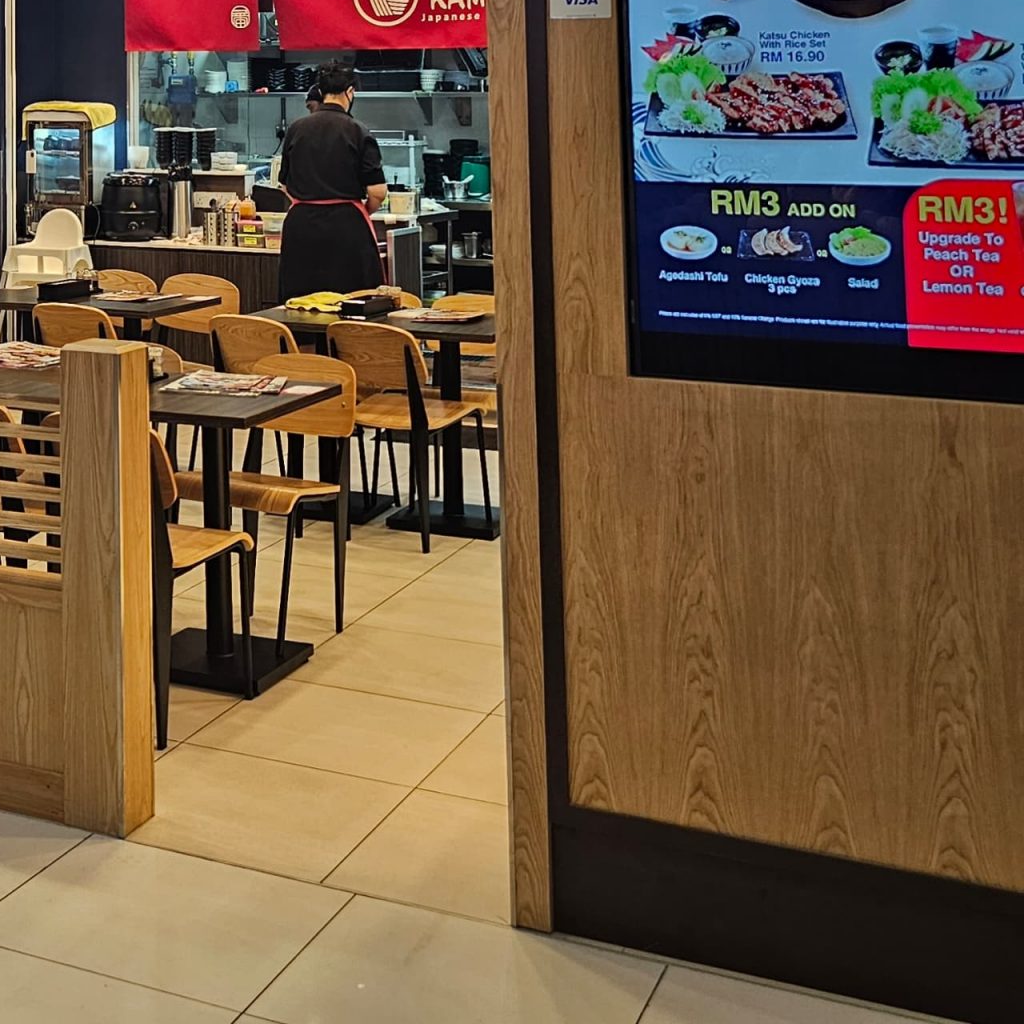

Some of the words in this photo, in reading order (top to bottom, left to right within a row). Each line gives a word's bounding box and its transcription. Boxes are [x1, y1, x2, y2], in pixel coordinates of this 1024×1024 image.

[420, 13, 480, 23] Japanese
[759, 31, 787, 41] Katsu
[790, 30, 830, 39] Chicken
[759, 40, 782, 49] With
[784, 39, 806, 48] Rice
[809, 39, 826, 48] Set
[760, 51, 783, 63] RM
[787, 50, 825, 62] 16.90
[710, 189, 781, 217] RM3
[787, 203, 825, 218] ADD
[829, 204, 856, 218] ON
[918, 195, 1008, 225] RM3!
[918, 231, 980, 247] Upgrade
[984, 232, 1004, 246] To
[924, 247, 969, 261] Peach
[972, 248, 1000, 263] Tea
[705, 271, 728, 282] Tofu
[949, 264, 974, 278] OR
[744, 273, 785, 284] Chicken
[787, 275, 821, 287] Gyoza
[848, 277, 880, 289] Salad
[768, 283, 776, 293] 3
[777, 284, 797, 295] pcs
[923, 279, 973, 294] Lemon
[976, 282, 1004, 296] Tea
